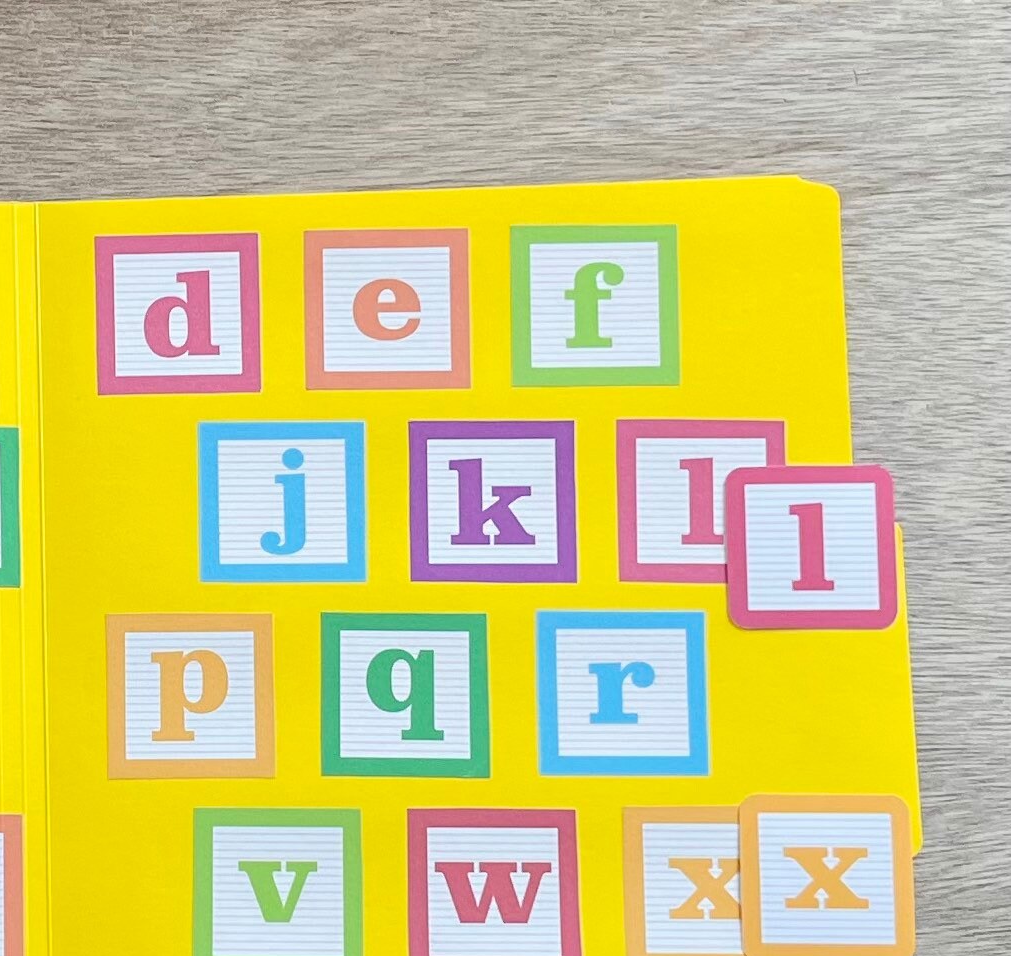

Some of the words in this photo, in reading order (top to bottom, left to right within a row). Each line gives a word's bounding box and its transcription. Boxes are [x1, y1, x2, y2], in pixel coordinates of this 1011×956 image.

[145, 270, 220, 358] d
[354, 279, 420, 340] e
[565, 262, 624, 348] f
[260, 448, 306, 555] j
[449, 459, 535, 545] k
[679, 458, 724, 545] l
[790, 503, 834, 591] l
[152, 650, 228, 741] p
[367, 649, 444, 741] q
[589, 662, 655, 724] r
[239, 861, 317, 922] v
[436, 862, 551, 923] w
[668, 858, 742, 919] x
[785, 848, 869, 909] x
